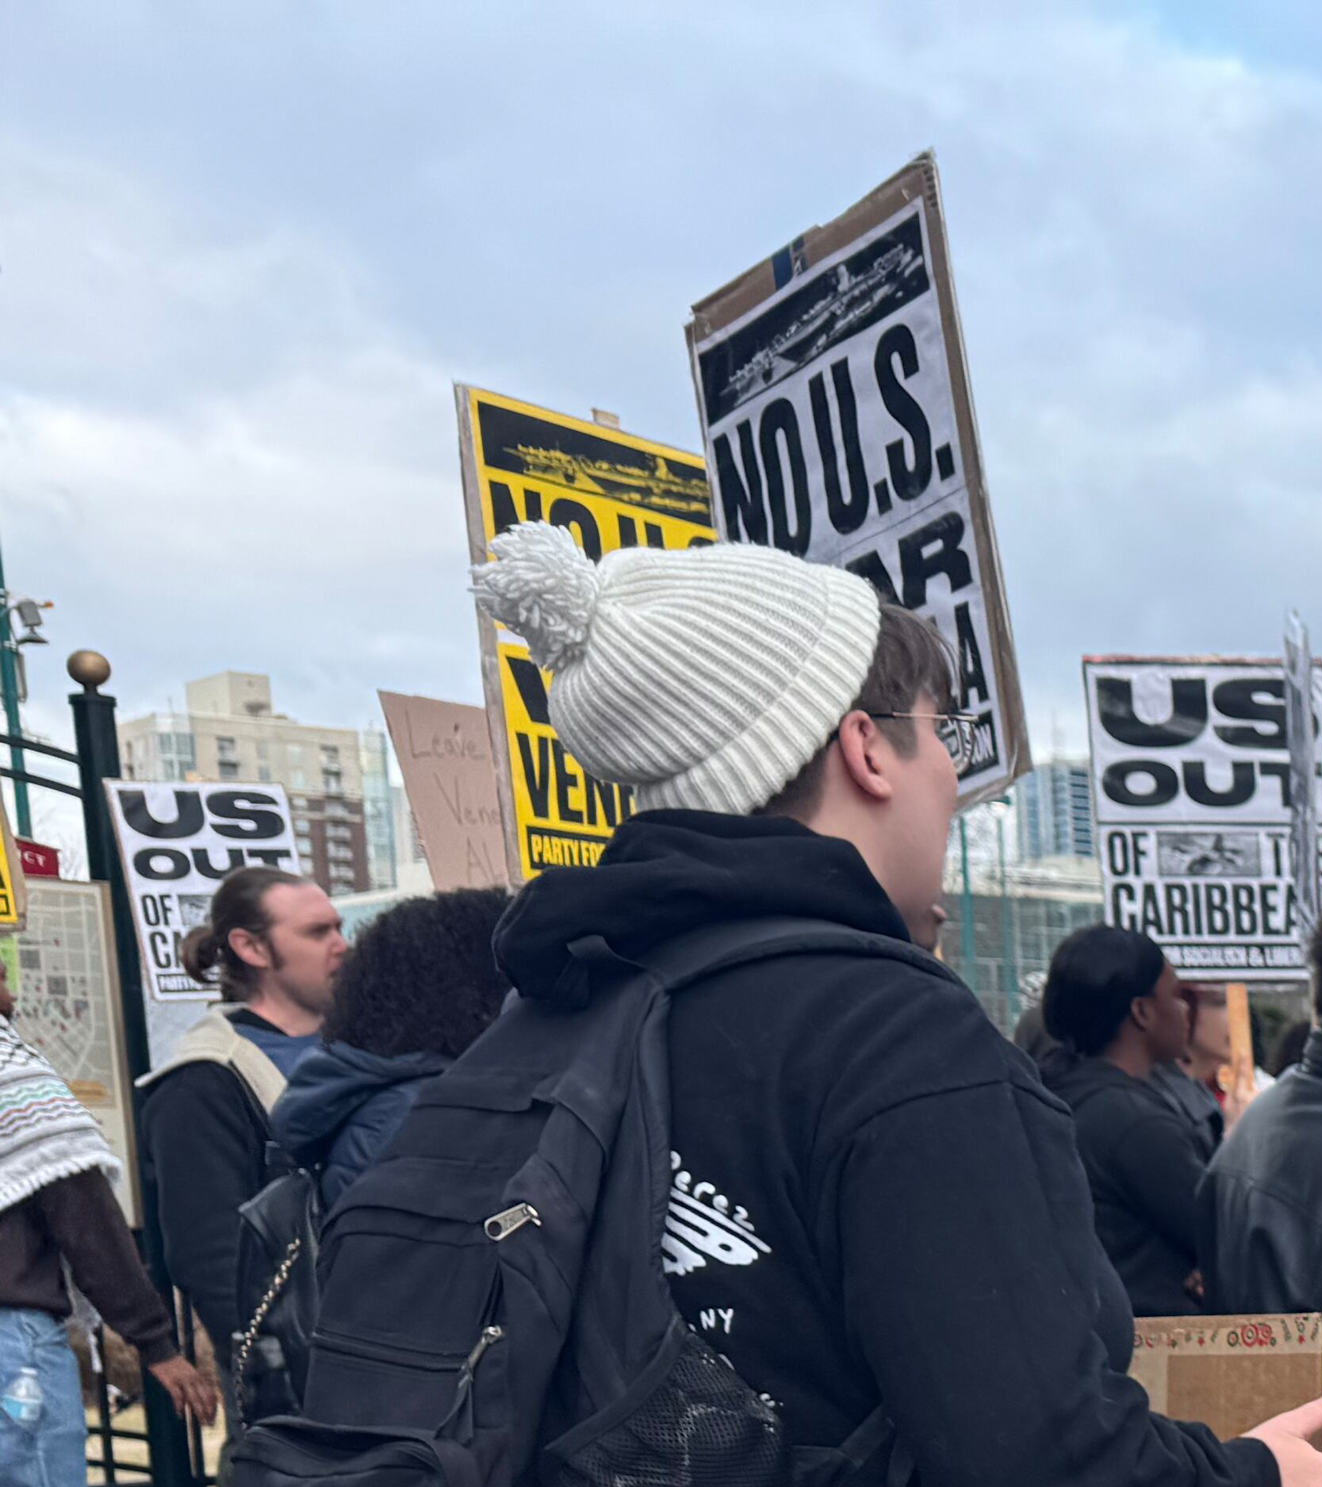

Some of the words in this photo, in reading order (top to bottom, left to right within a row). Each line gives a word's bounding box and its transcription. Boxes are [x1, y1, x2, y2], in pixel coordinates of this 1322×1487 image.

[713, 397, 812, 559] NO
[808, 323, 955, 535] U.S.
[1096, 677, 1320, 749] US
[1103, 760, 1322, 808] OUT
[117, 788, 285, 840] US
[133, 847, 291, 880] OUT
[531, 834, 578, 867] PARTY
[1107, 831, 1149, 878] OF
[141, 894, 173, 927] OF
[700, 1307, 734, 1335] NY
